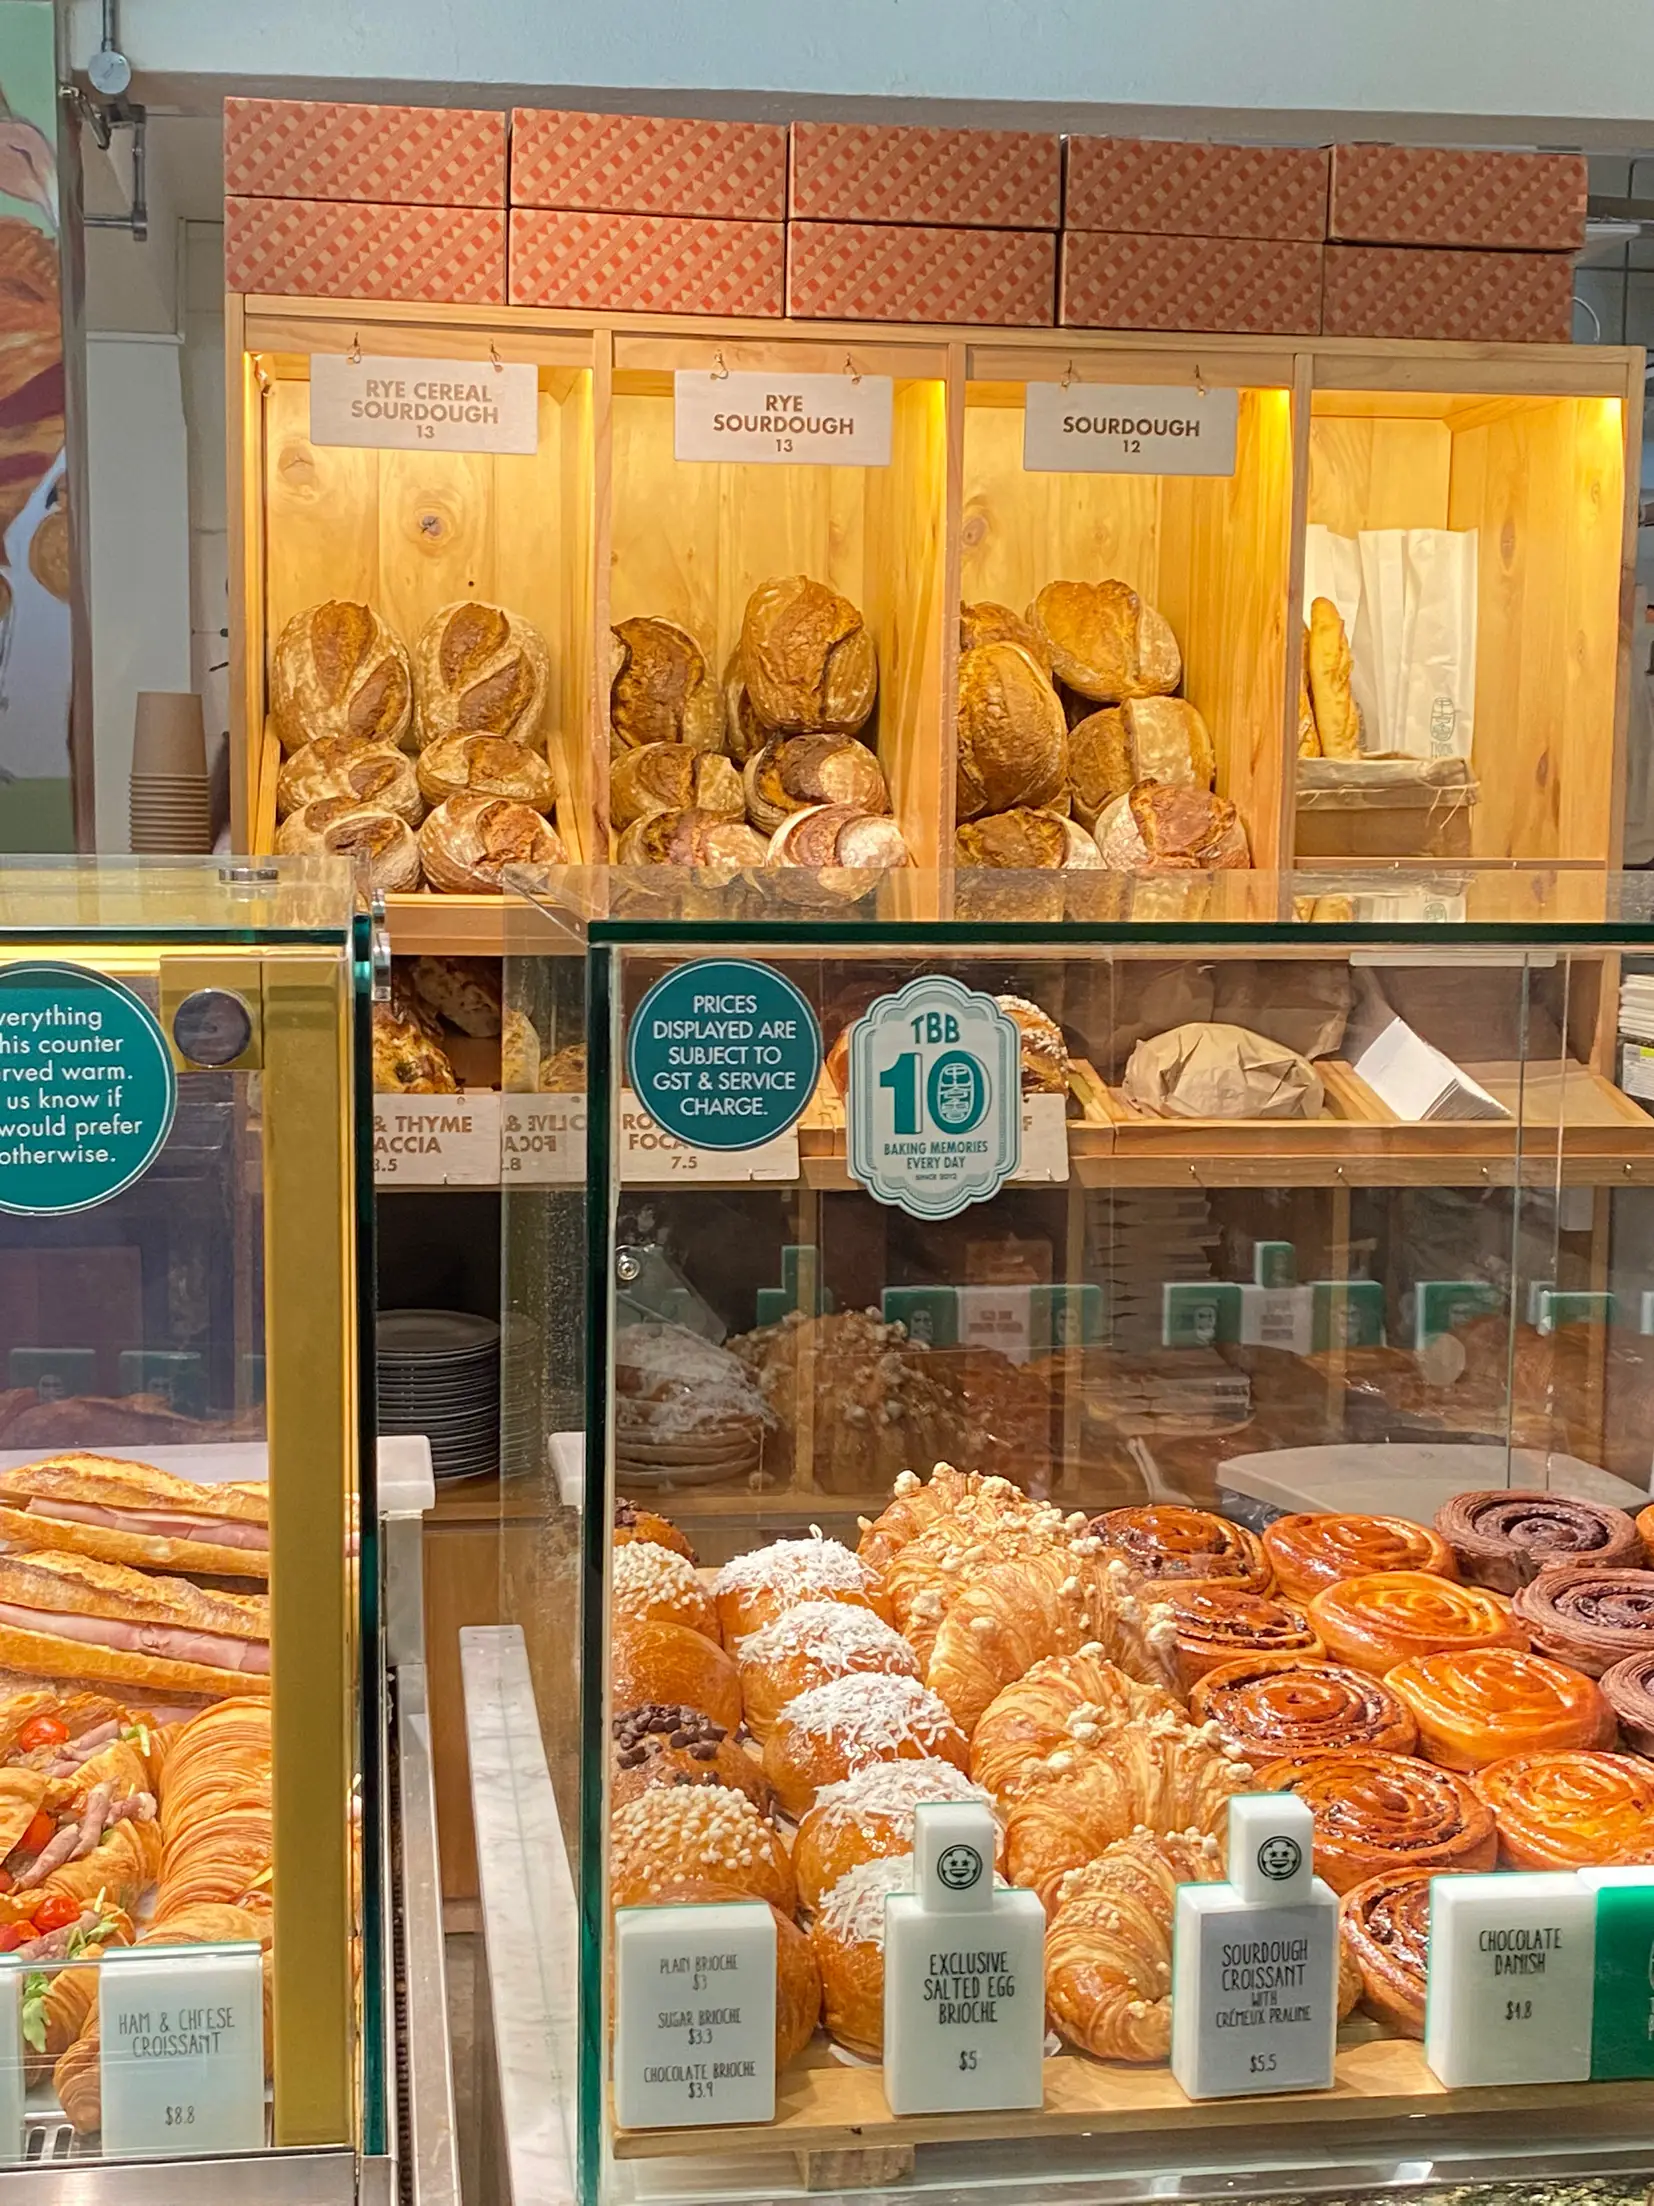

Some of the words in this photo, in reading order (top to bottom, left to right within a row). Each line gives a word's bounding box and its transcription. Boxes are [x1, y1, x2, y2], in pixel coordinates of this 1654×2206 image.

[366, 379, 406, 398] RYE
[414, 382, 492, 402] CEREAL
[351, 400, 499, 424] SOURDOUGH
[765, 394, 803, 412] RYE
[416, 425, 435, 439] 13
[713, 414, 854, 435] SOURDOUGH
[1062, 416, 1200, 437] SOURDOUGH
[776, 438, 793, 452] 13
[1123, 440, 1141, 453] 12
[693, 995, 758, 1014] PRICES
[0, 1004, 103, 1031] verything
[910, 1012, 961, 1044] TBB
[653, 1020, 754, 1040] DISPLAYED
[758, 1020, 797, 1039] ARE
[0, 1032, 30, 1054] his
[38, 1037, 124, 1053] counter
[668, 1046, 749, 1065] SUBJECT
[753, 1046, 782, 1065] TO
[0, 1060, 53, 1081] rved
[61, 1066, 134, 1081] warm.
[653, 1072, 692, 1091] GST
[698, 1071, 713, 1090] &
[718, 1071, 796, 1091] SERVICE
[7, 1095, 30, 1110] us
[39, 1088, 99, 1109] know
[107, 1086, 123, 1107] if
[880, 1050, 993, 1135] 10
[680, 1097, 768, 1116] CHARGE.
[0, 1114, 66, 1137] would
[75, 1113, 143, 1141] prefer
[395, 1115, 473, 1133] THYME
[0, 1143, 116, 1165] otherwise.
[373, 1136, 442, 1154] ACCIA
[884, 1143, 927, 1156] BAKING
[930, 1141, 988, 1154] MEMORIES
[671, 1156, 698, 1170] 7.5
[907, 1157, 941, 1170] EVERY
[944, 1156, 966, 1169] DAY
[1479, 1928, 1563, 1952] CHOCOLATE
[660, 1957, 691, 1974] PLAIN
[695, 1954, 739, 1973] BRIOCHE
[930, 1951, 1009, 1976] EXCLUSIVE
[1222, 1939, 1308, 1968] SOURDOUGH
[1494, 1953, 1546, 1977] DANISH
[692, 1973, 708, 1991] $3
[1222, 1963, 1306, 1991] CROISSANT
[924, 1976, 980, 2001] SALTED
[988, 1975, 1015, 1998] EGG
[1251, 1990, 1278, 2006] WITH
[118, 2012, 151, 2035] HAM
[159, 2012, 170, 2032] &
[658, 2010, 693, 2029] SUGAR
[699, 2007, 742, 2026] BRIOCHE
[939, 2001, 998, 2025] BRIOCHE
[1269, 2005, 1312, 2024] PRALINE
[132, 2031, 222, 2057] CROISSANT
[688, 2028, 713, 2045] $3.3
[958, 2050, 978, 2071] $5
[1250, 2054, 1277, 2073] $5.5
[643, 2064, 708, 2083] CHOCOLATE
[713, 2061, 756, 2078] BRIOCHE
[688, 2081, 714, 2099] $3.9
[165, 2106, 195, 2126] $8.8
